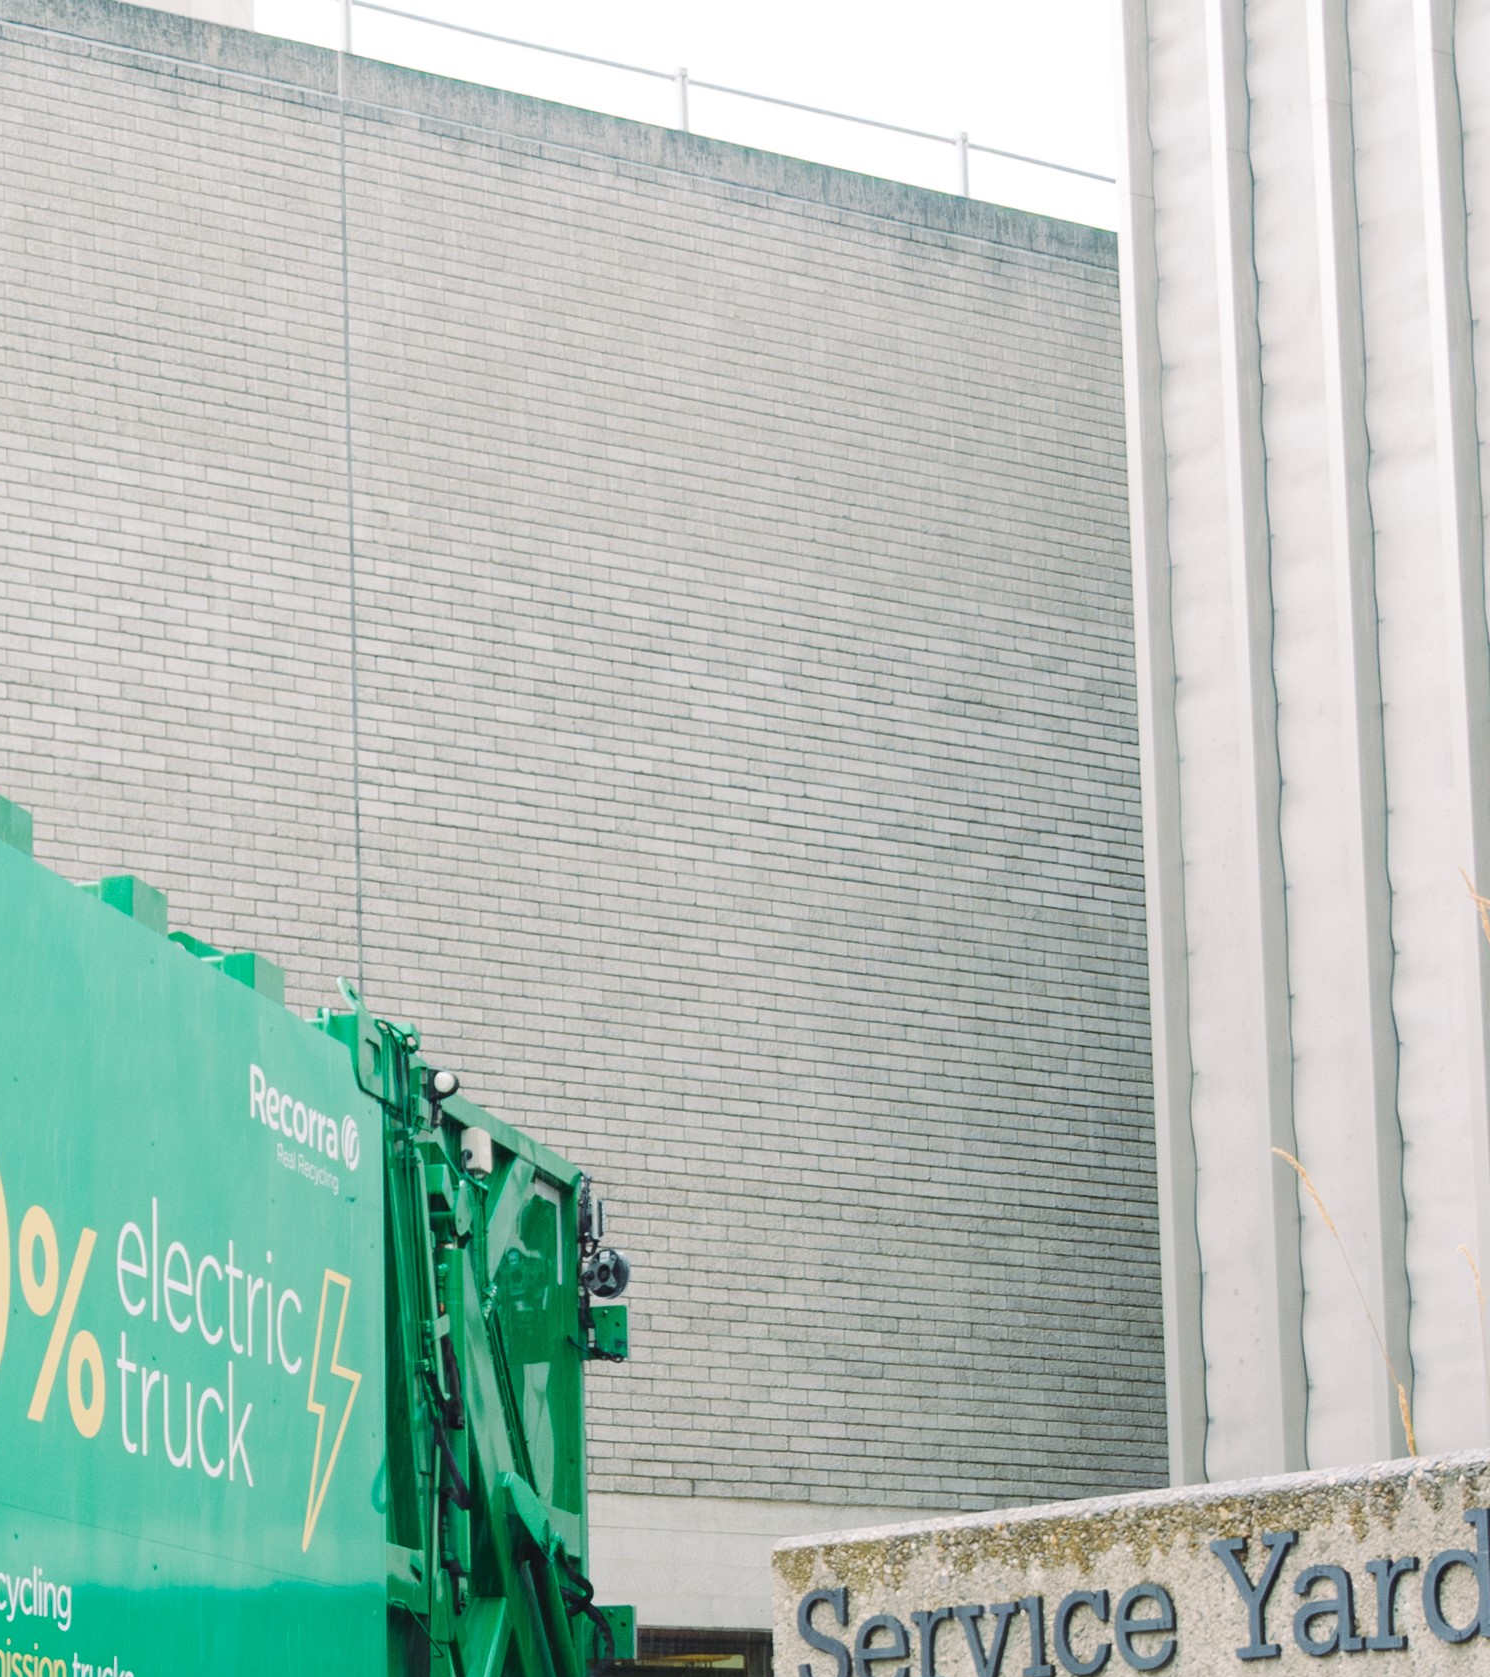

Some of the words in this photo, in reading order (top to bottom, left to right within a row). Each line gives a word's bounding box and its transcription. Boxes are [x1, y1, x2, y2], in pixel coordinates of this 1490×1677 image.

[250, 1064, 338, 1160] Recorra
[276, 1143, 296, 1169] Real
[298, 1154, 339, 1195] Recycling
[116, 1196, 303, 1374] electric
[116, 1331, 254, 1487] truck
